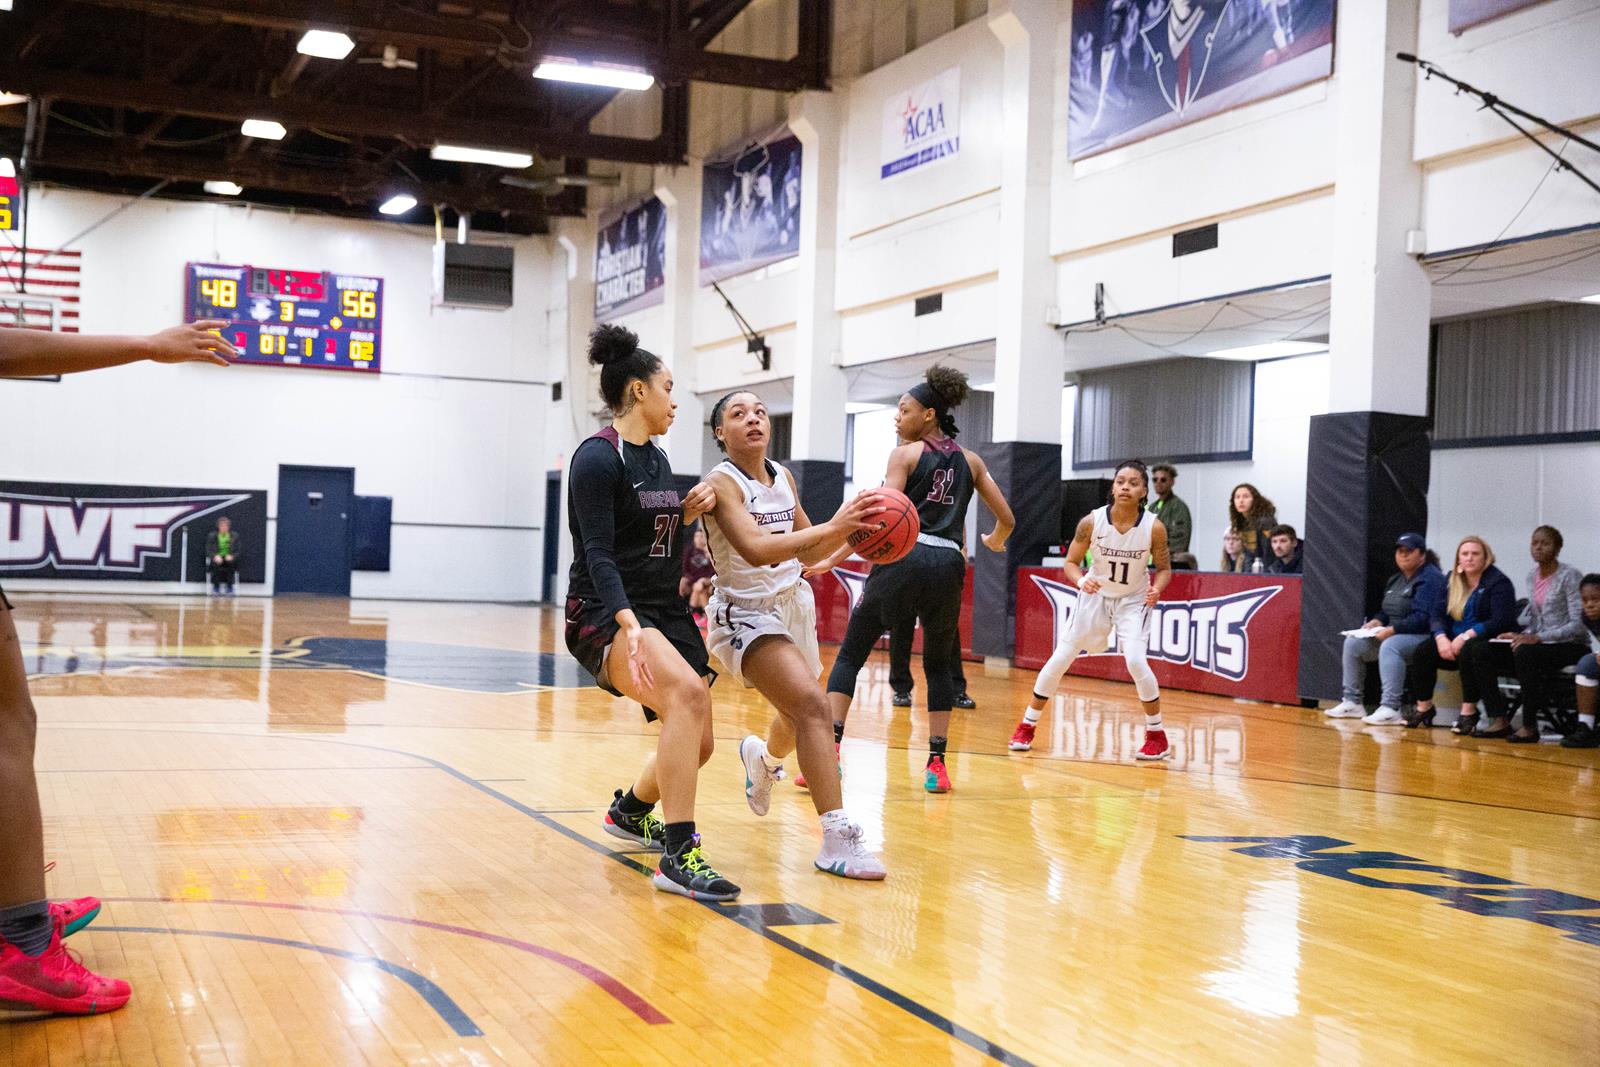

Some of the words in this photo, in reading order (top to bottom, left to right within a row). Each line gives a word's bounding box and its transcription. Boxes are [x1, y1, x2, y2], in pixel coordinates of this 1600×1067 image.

[904, 101, 945, 144] ACAA
[202, 279, 237, 308] 48
[342, 290, 376, 319] 56
[280, 301, 294, 322] 3
[926, 468, 954, 504] 32
[754, 507, 795, 526] PATRIOT
[0, 501, 200, 564] UVF
[648, 514, 679, 557] 21
[1099, 545, 1144, 560] PATRIOTS
[1108, 560, 1129, 585] 11
[1032, 577, 1282, 681] PIOTS
